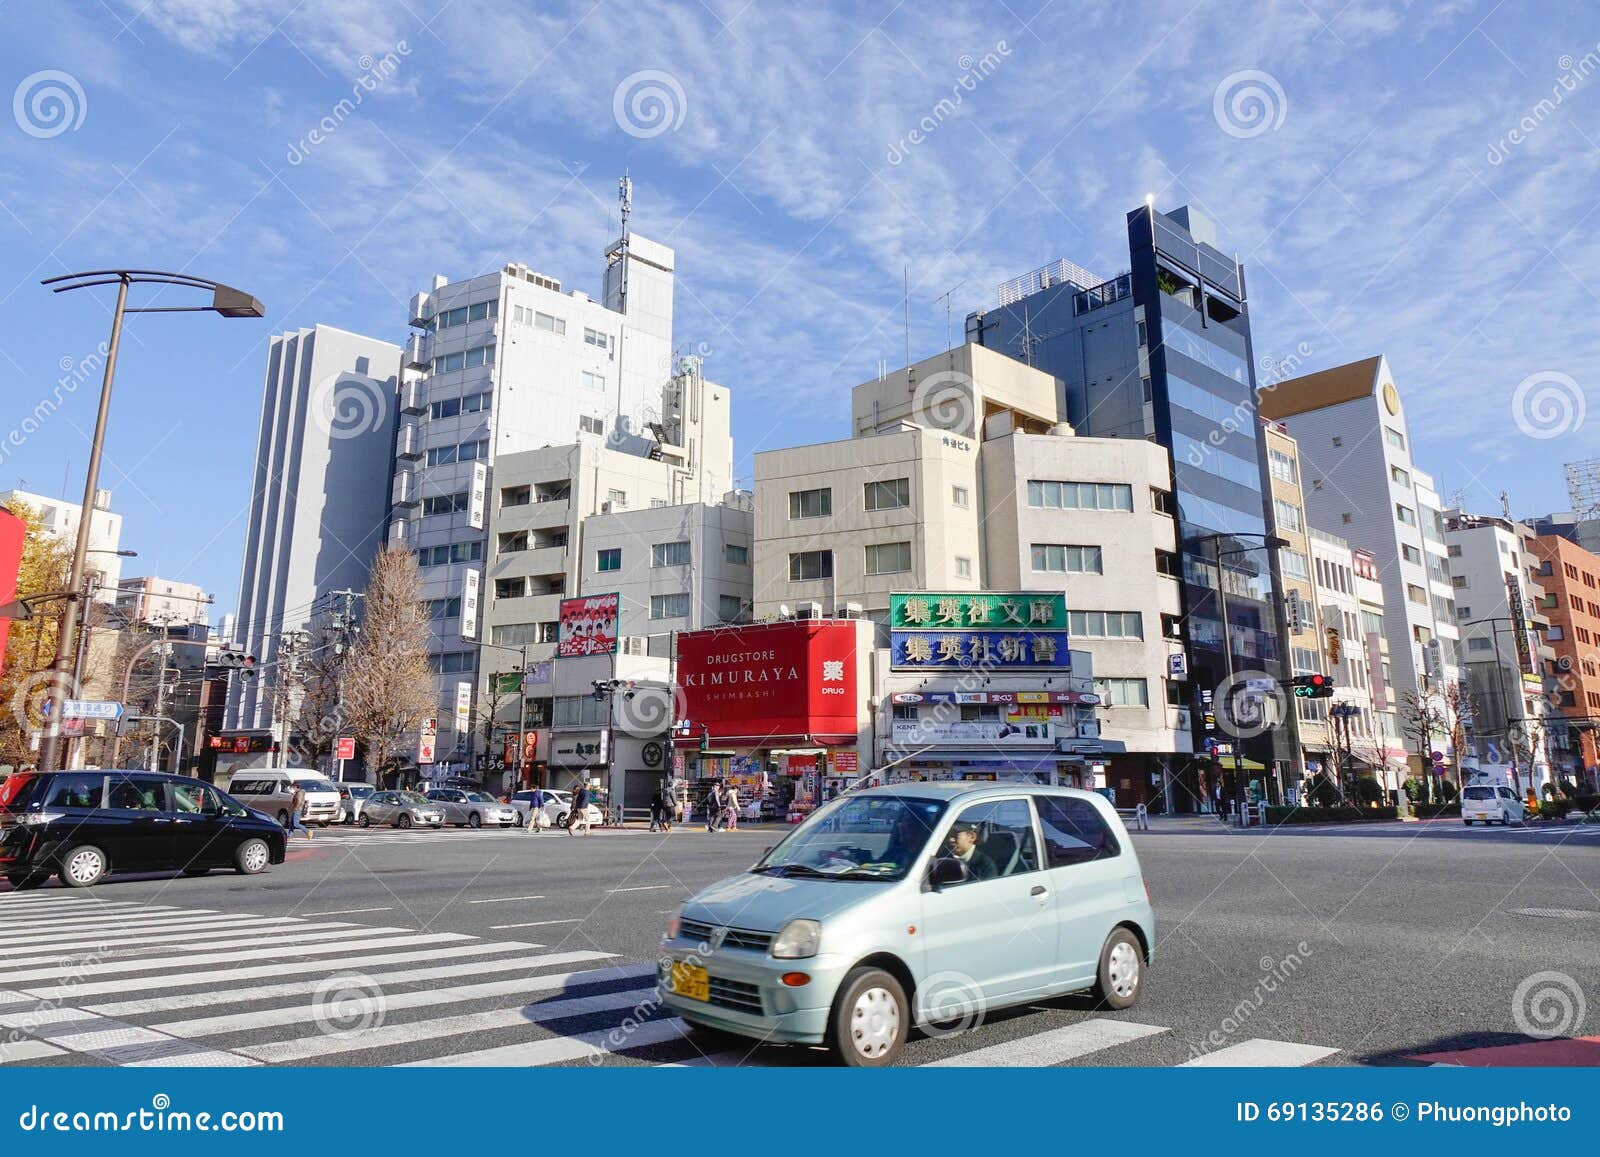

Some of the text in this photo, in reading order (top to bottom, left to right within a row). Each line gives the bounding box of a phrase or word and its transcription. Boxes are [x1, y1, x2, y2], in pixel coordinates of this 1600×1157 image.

[905, 597, 1054, 624] 集英社文庫
[707, 650, 775, 665] DRUGSTORE
[905, 635, 1058, 662] 集英社新書
[685, 666, 799, 687] KIMURAYA
[823, 660, 844, 681] 薬
[706, 689, 775, 701] SHIMBASHI
[821, 687, 845, 695] DRUG
